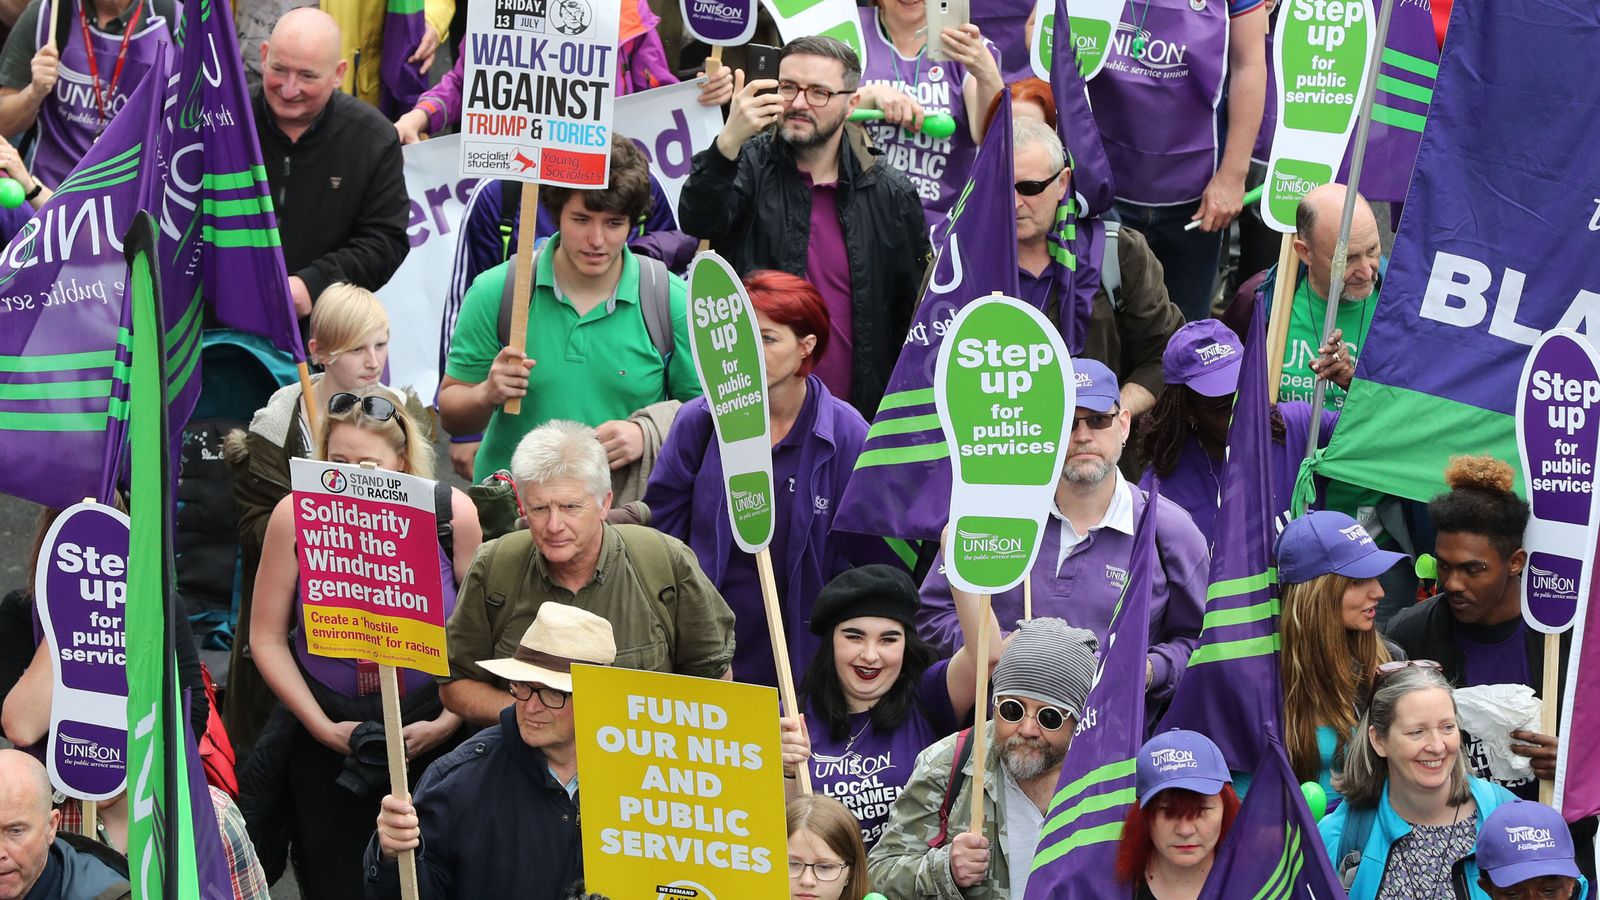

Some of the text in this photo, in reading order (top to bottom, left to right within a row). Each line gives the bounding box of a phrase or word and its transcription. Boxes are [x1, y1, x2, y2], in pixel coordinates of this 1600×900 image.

[497, 0, 545, 16] FRIDAY,
[693, 2, 742, 17] UNISON
[1293, 0, 1364, 27] Step
[496, 14, 540, 29] 13 JULY
[1112, 33, 1187, 64] NISON
[1307, 25, 1346, 52] up
[472, 33, 612, 78] WALK-OUT
[1311, 55, 1336, 70] for
[1130, 67, 1162, 78] service
[1163, 68, 1189, 79] union
[1296, 73, 1347, 89] public
[468, 69, 610, 121] AGAINST
[1286, 90, 1354, 105] services
[466, 113, 607, 147] TRUMP & TORIES
[467, 159, 511, 170] students
[468, 150, 509, 164] socialist
[543, 152, 580, 167] Young
[545, 165, 601, 181] Socialists
[694, 291, 743, 328] Step
[710, 321, 738, 352] up
[957, 338, 1054, 371] Step
[721, 359, 738, 375] for
[717, 373, 752, 399] public
[980, 369, 1032, 399] up
[1532, 370, 1600, 409] Step
[715, 389, 762, 417] services
[991, 403, 1023, 419] for
[972, 420, 1041, 441] public
[1548, 405, 1585, 435] up
[960, 439, 1055, 456] services
[1554, 438, 1578, 455] for
[1541, 457, 1591, 475] public
[350, 473, 402, 490] STAND UP
[352, 484, 408, 503] TO RACISM
[735, 491, 766, 512] UNISON
[300, 497, 411, 539] Solidarity
[303, 524, 397, 557] with the
[963, 537, 1022, 552] UNISON
[57, 542, 129, 577] Ste
[304, 547, 416, 586] Windrush
[1533, 575, 1574, 591] UNISON
[307, 578, 429, 614] generation
[90, 611, 121, 629] for
[311, 611, 349, 626] Create
[352, 616, 359, 626] a
[73, 631, 126, 648] publi
[386, 636, 402, 650] for
[405, 641, 441, 658] racism
[61, 648, 126, 665] servic
[627, 694, 728, 731] FUND
[64, 743, 120, 761] UNISON
[596, 725, 763, 770] OUR NHS
[73, 759, 90, 767] public
[815, 751, 891, 778] UNISON
[641, 765, 723, 798] AND
[823, 775, 885, 797] LOCAL
[619, 795, 750, 838] PUBLIC
[1509, 828, 1551, 843] UNISON
[600, 827, 773, 875] SERVICES
[669, 888, 695, 896] DEMAND
